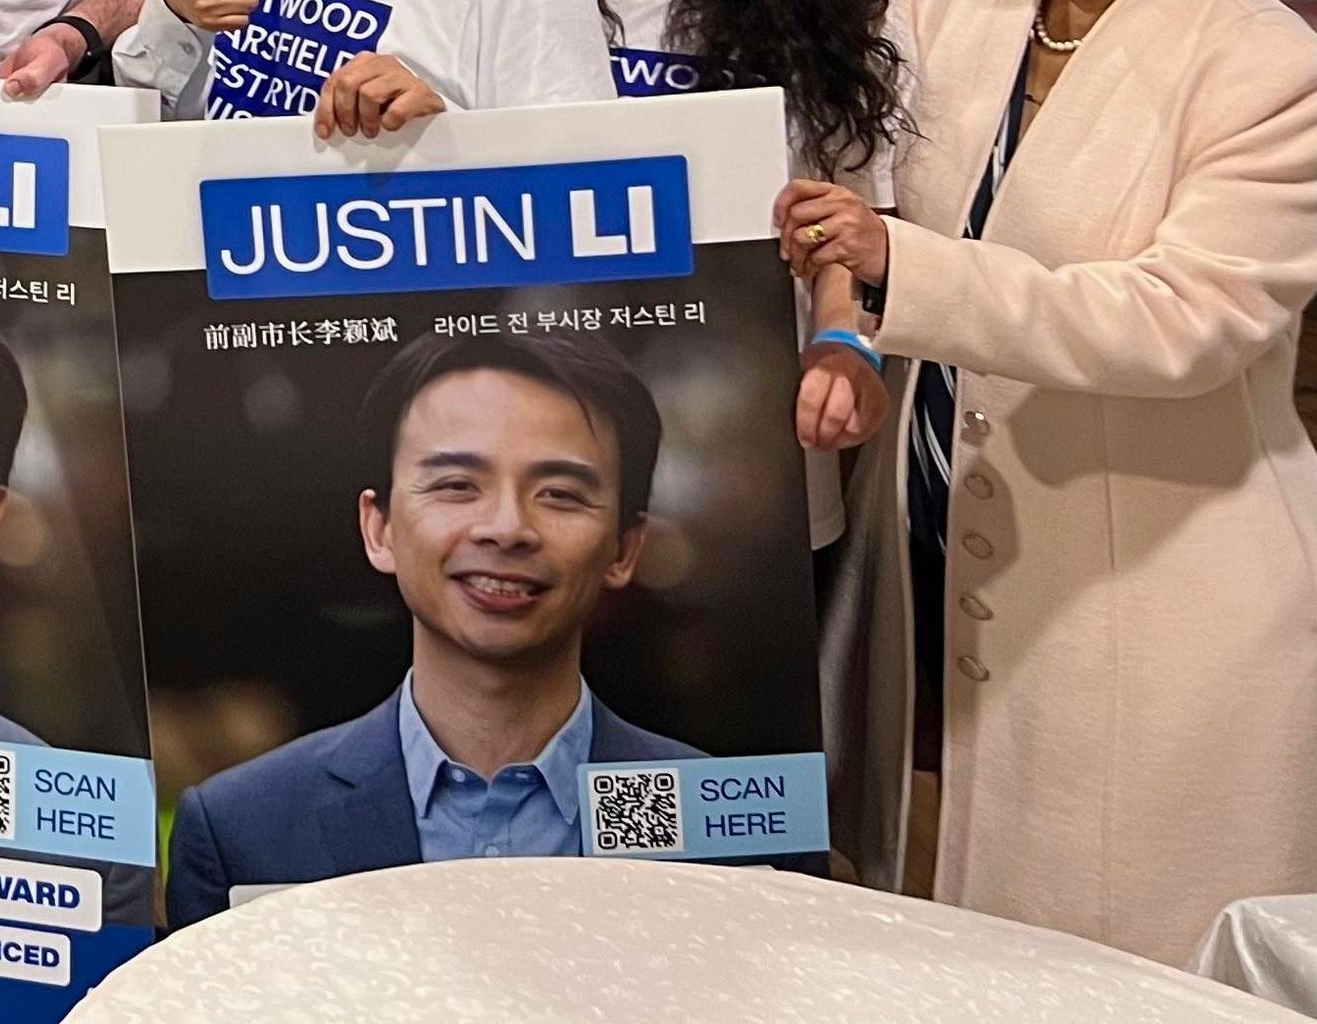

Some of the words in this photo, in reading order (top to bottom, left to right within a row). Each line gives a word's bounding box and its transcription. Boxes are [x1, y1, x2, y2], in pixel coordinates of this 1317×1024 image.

[207, 45, 269, 98] EST
[263, 77, 320, 117] RYD
[220, 192, 536, 276] JUSTIN
[569, 185, 657, 259] LI
[56, 281, 76, 305] 리
[202, 316, 398, 351] 前副市长李颖斌
[434, 312, 499, 338] 라이드
[507, 310, 529, 335] 전
[536, 306, 602, 333] 부시장
[609, 302, 678, 330] 저스틴
[685, 301, 706, 325] 리
[33, 768, 116, 802] SCAN
[700, 775, 785, 803] SCAN
[37, 807, 116, 842] HERE
[705, 810, 787, 837] HERE
